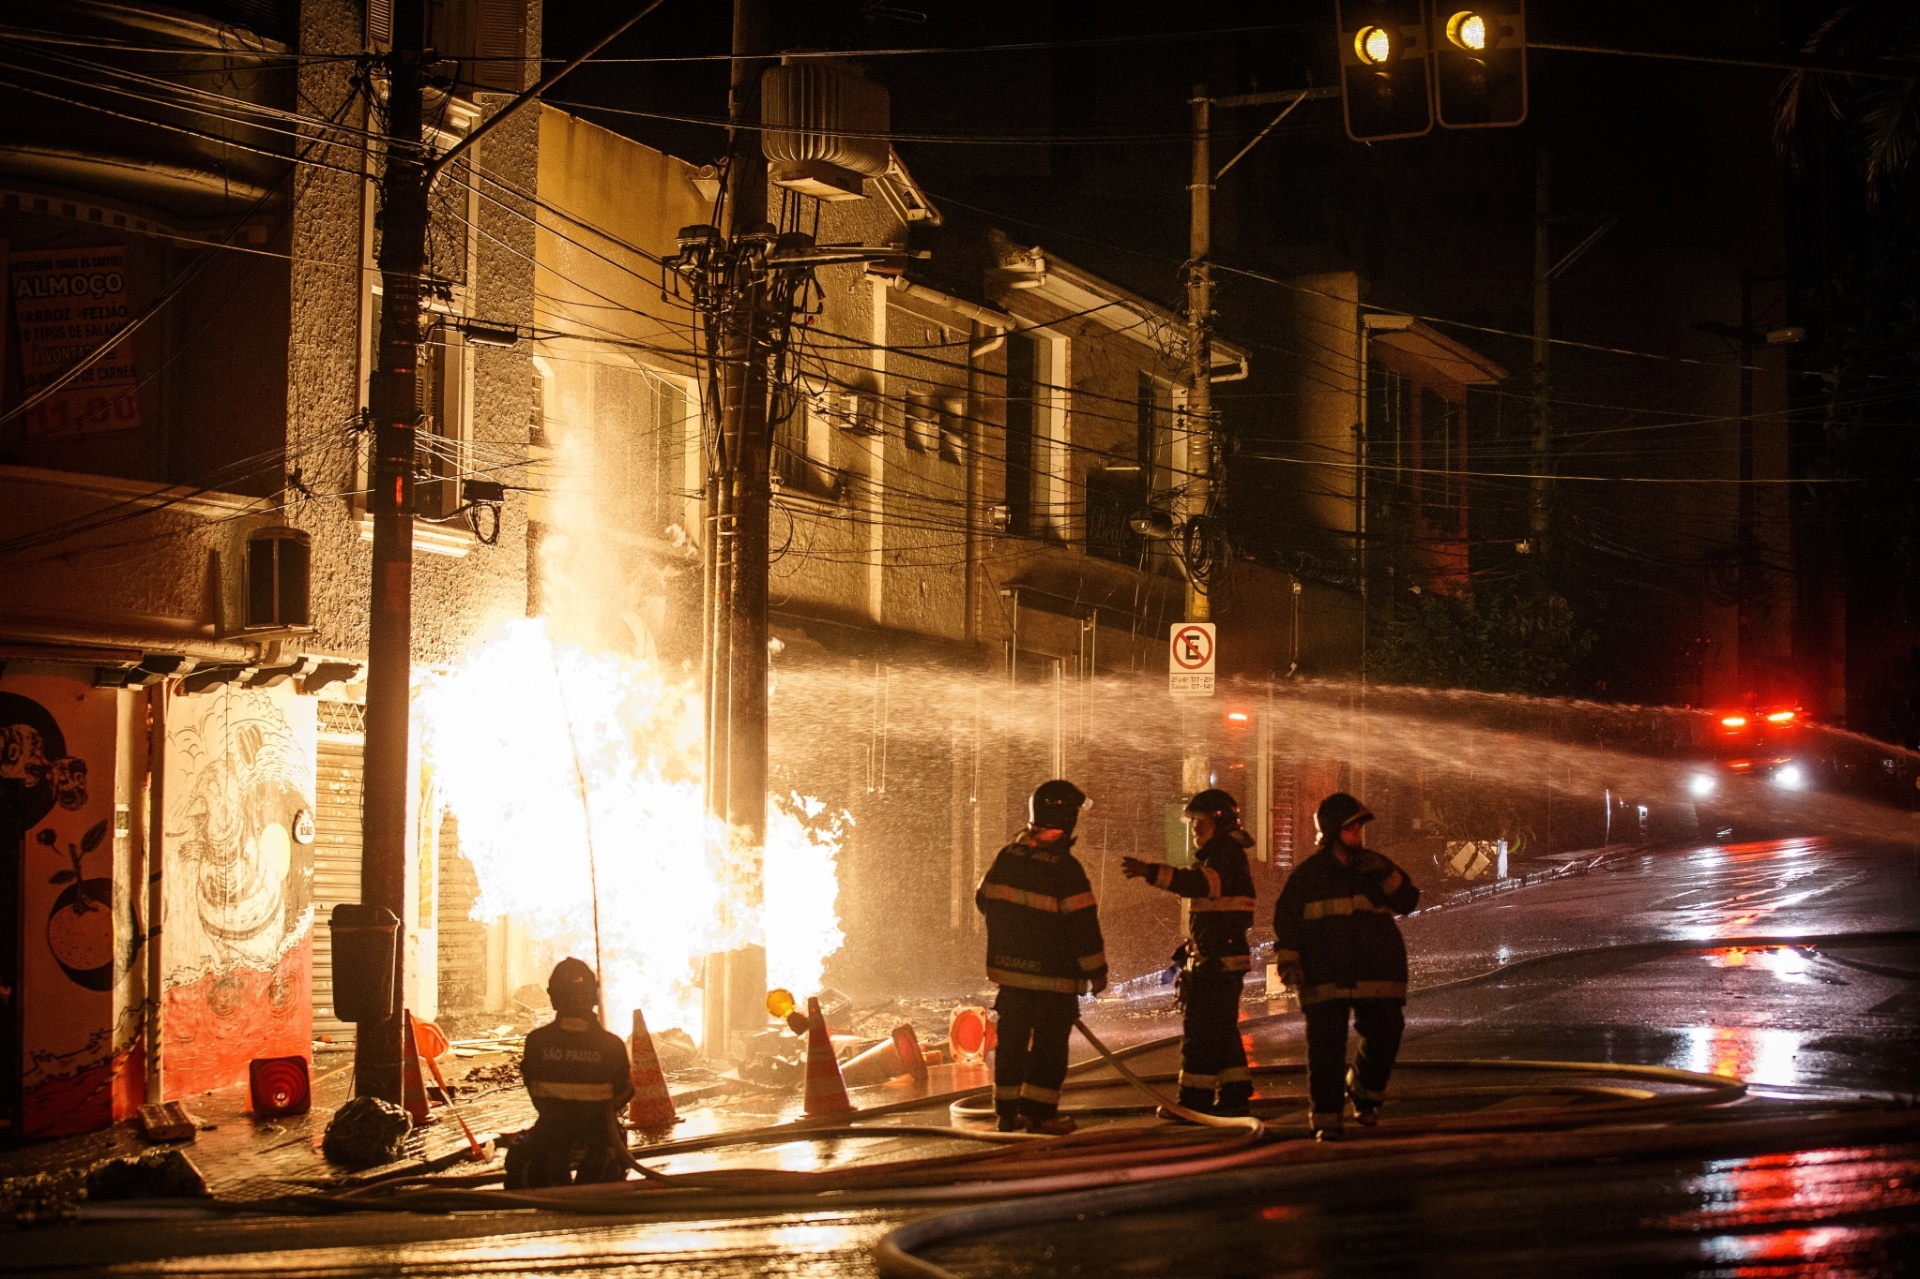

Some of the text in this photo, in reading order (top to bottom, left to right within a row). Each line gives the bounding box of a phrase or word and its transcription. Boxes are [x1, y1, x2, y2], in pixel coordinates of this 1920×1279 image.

[15, 271, 124, 299] ALMOÇO
[26, 301, 128, 322] ARROZ FEIJÃO
[33, 326, 66, 341] TIPOS
[69, 324, 82, 339] DE
[82, 368, 94, 382] DE
[98, 364, 138, 381] CARNES
